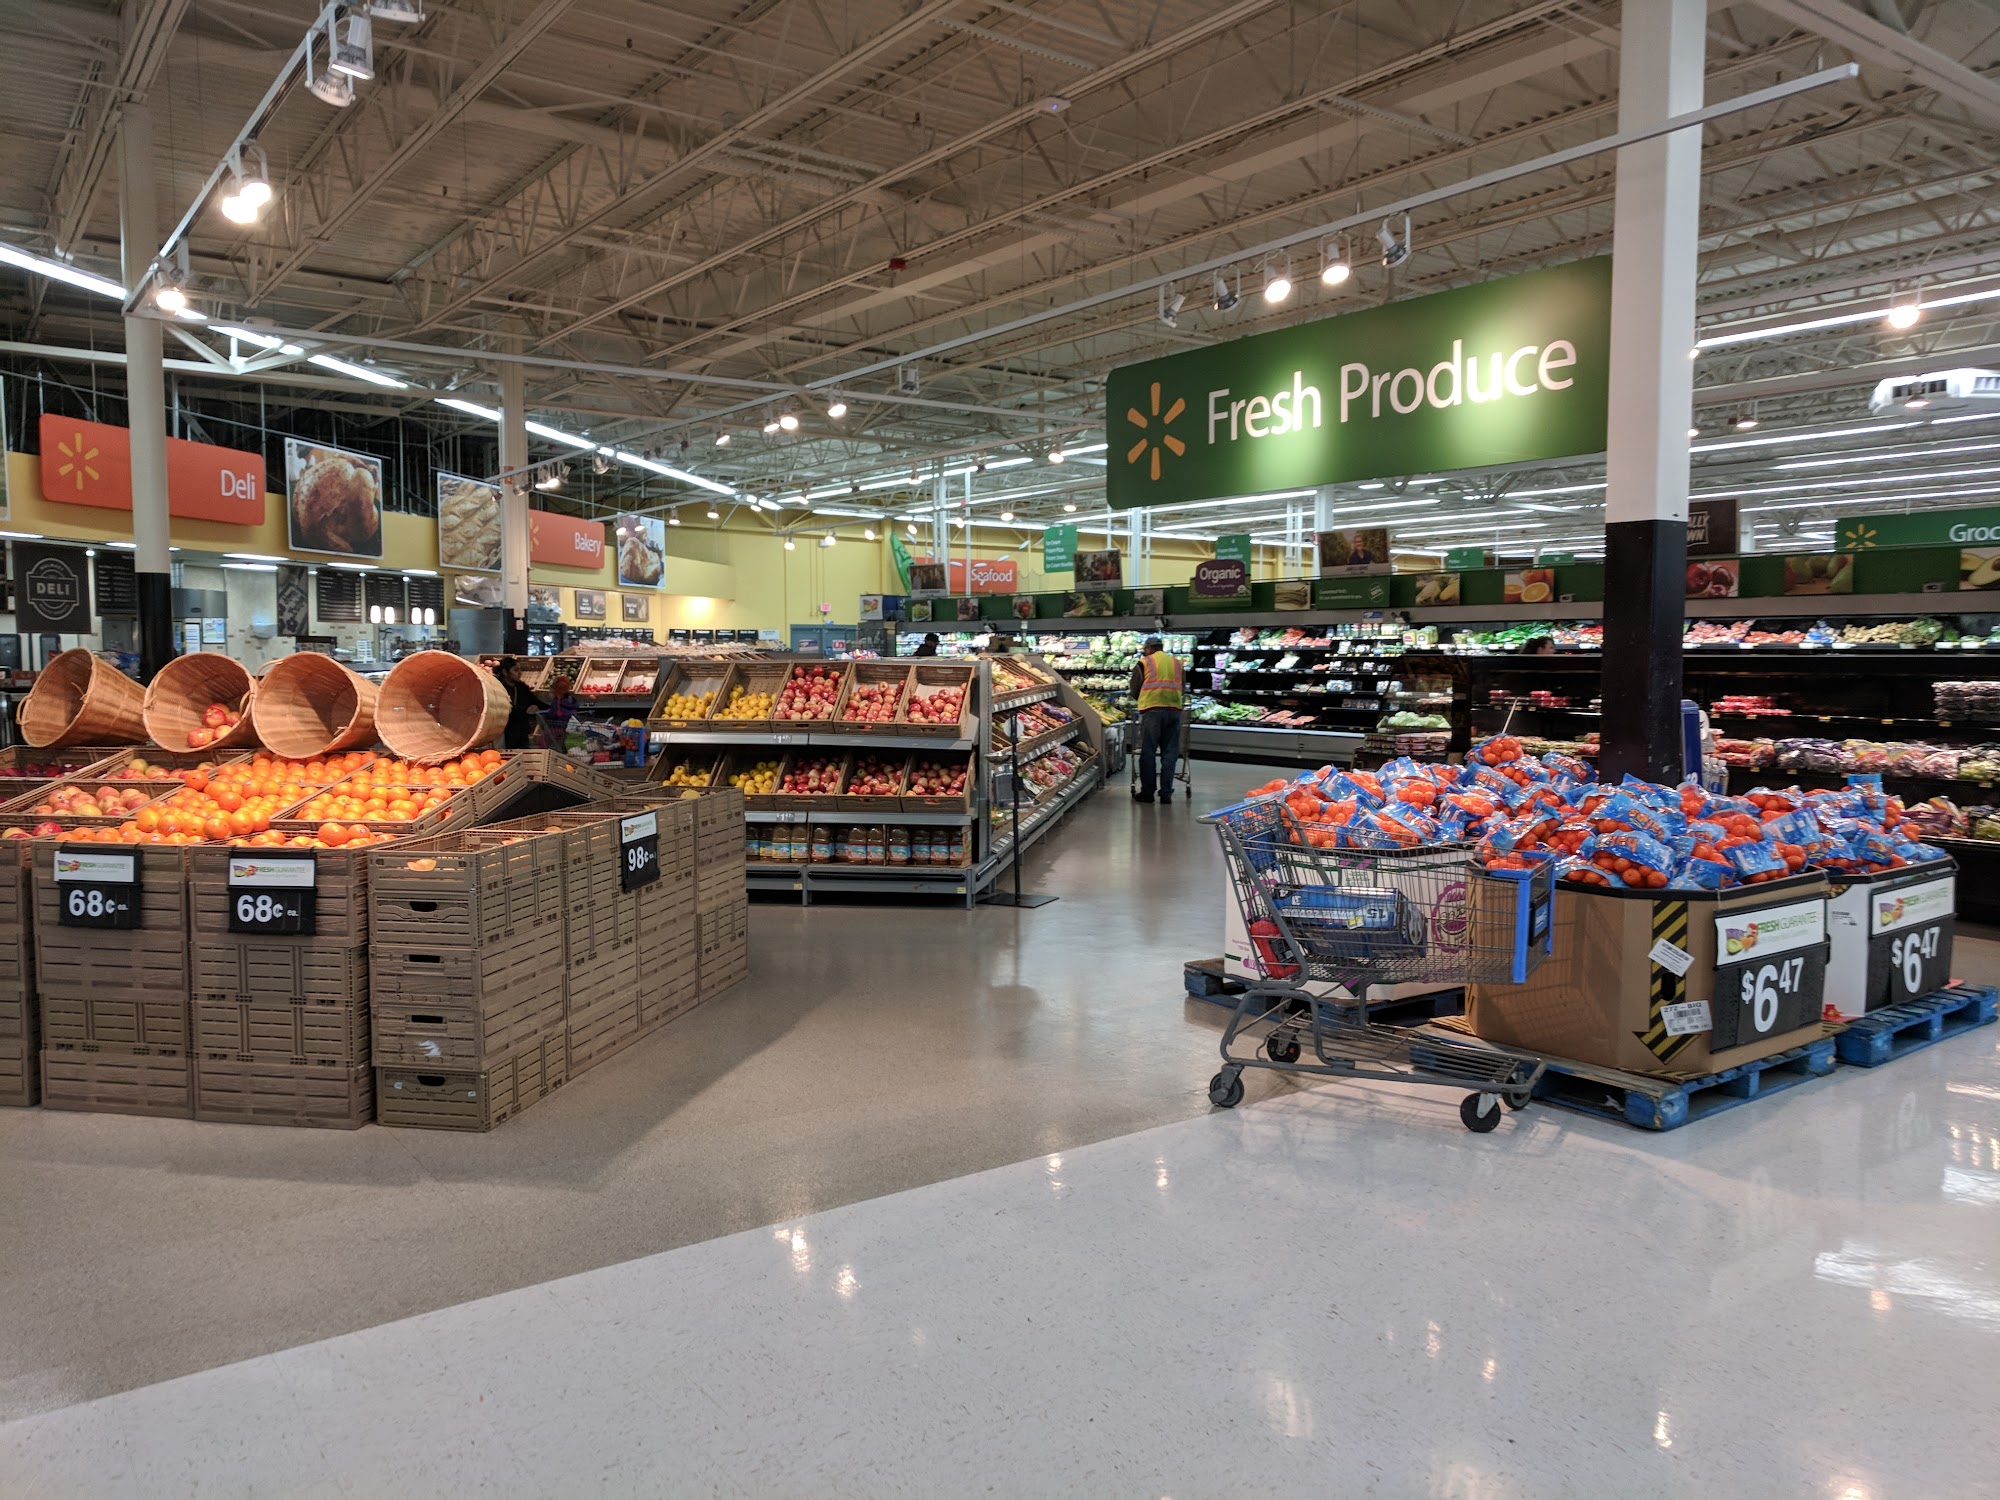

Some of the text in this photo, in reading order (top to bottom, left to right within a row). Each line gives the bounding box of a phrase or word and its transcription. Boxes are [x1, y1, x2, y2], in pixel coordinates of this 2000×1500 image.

[1208, 339, 1577, 444] Fresh Produce
[221, 469, 256, 500] Deli
[575, 532, 601, 558] Bakery
[971, 568, 1013, 582] Seafood
[1199, 564, 1241, 584] Organic
[36, 582, 70, 596] DELI
[68, 889, 115, 917] 68¢
[237, 894, 299, 922] 68¢ ea.
[1757, 919, 1779, 934] FRESH
[1780, 911, 1817, 930] GUARANTEE
